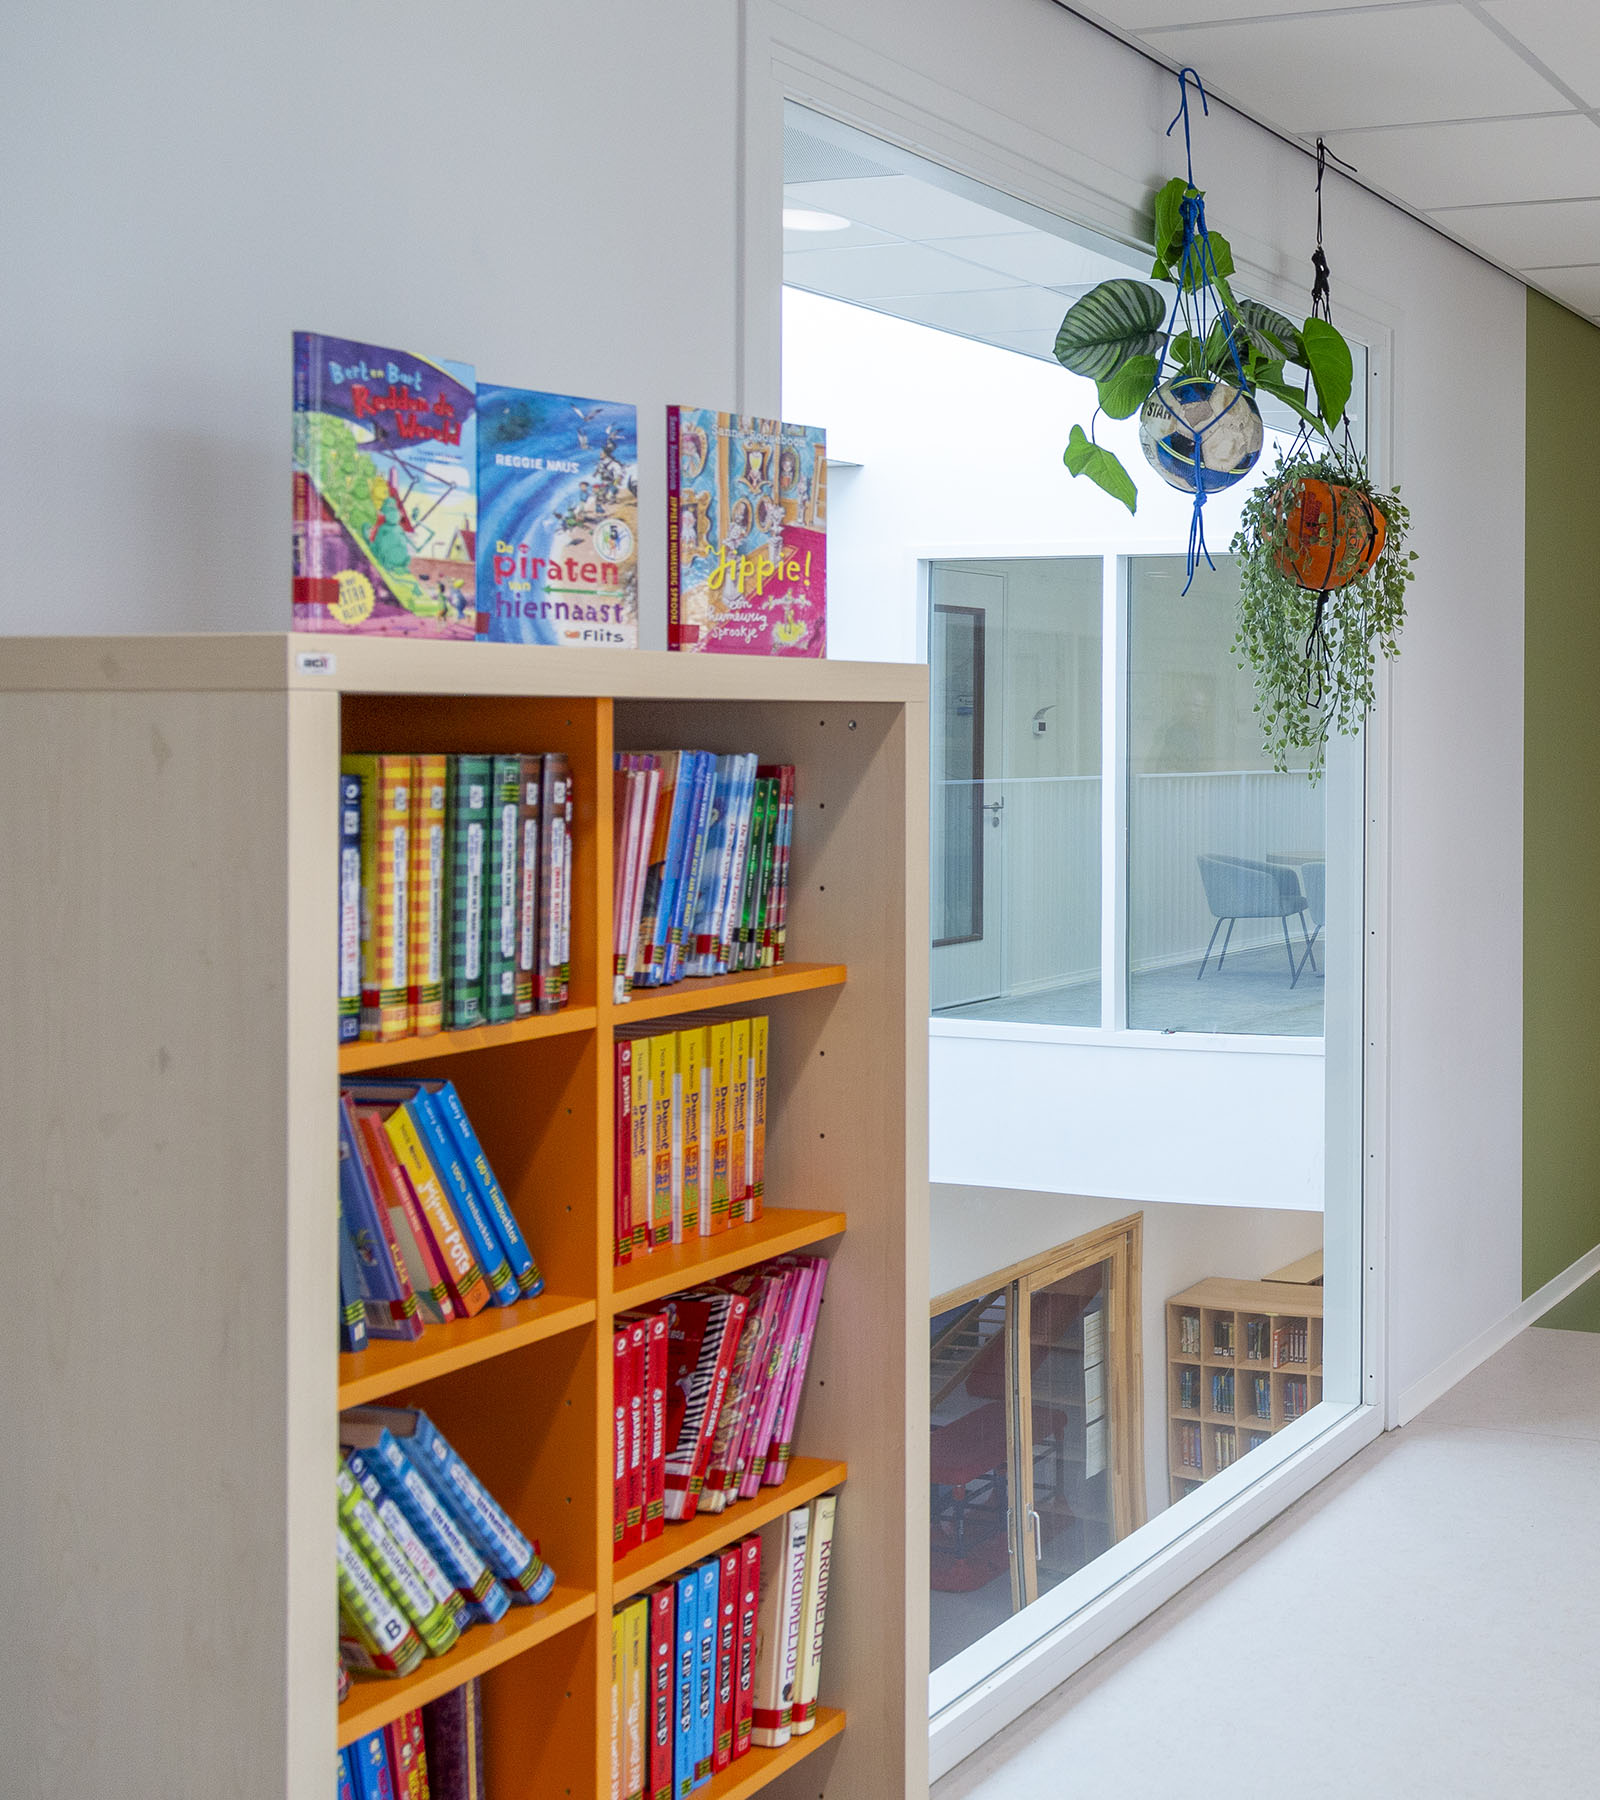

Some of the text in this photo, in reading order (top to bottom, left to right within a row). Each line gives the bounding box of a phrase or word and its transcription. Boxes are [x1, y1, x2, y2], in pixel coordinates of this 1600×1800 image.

[328, 360, 422, 391] Bert en Bart
[352, 384, 454, 419] Redden de
[394, 410, 462, 446] Wereld
[496, 454, 580, 474] REGGIE NAUS
[496, 540, 514, 554] De
[610, 526, 618, 539] 5
[493, 544, 619, 585] piraten
[705, 544, 812, 596] Jippie!
[508, 581, 531, 591] van
[496, 592, 624, 624] hiernaast
[670, 587, 678, 624] SPROOKJ
[584, 628, 624, 643] Flits
[711, 626, 759, 644] sprookje
[689, 858, 699, 876] ACHT
[685, 892, 693, 902] DE
[687, 876, 696, 891] AAN
[681, 902, 692, 927] MACHT
[424, 1100, 436, 1125] Carry
[448, 1094, 470, 1139] Carry Slee
[661, 1098, 670, 1150] Dummie
[690, 1092, 699, 1142] Dummie
[720, 1086, 728, 1135] Dummie
[639, 1104, 647, 1156] Dummie
[451, 1162, 495, 1251] 100% Timboektoe
[474, 1154, 518, 1245] 100% Timboektoe
[705, 1410, 718, 1437] ZEBRA
[632, 1438, 640, 1469] ZEBRA
[652, 1430, 661, 1460] ZEBRA
[616, 1449, 625, 1480] ZEBRA
[812, 1540, 832, 1666] KRUIMELTJE
[385, 1618, 403, 1640] B
